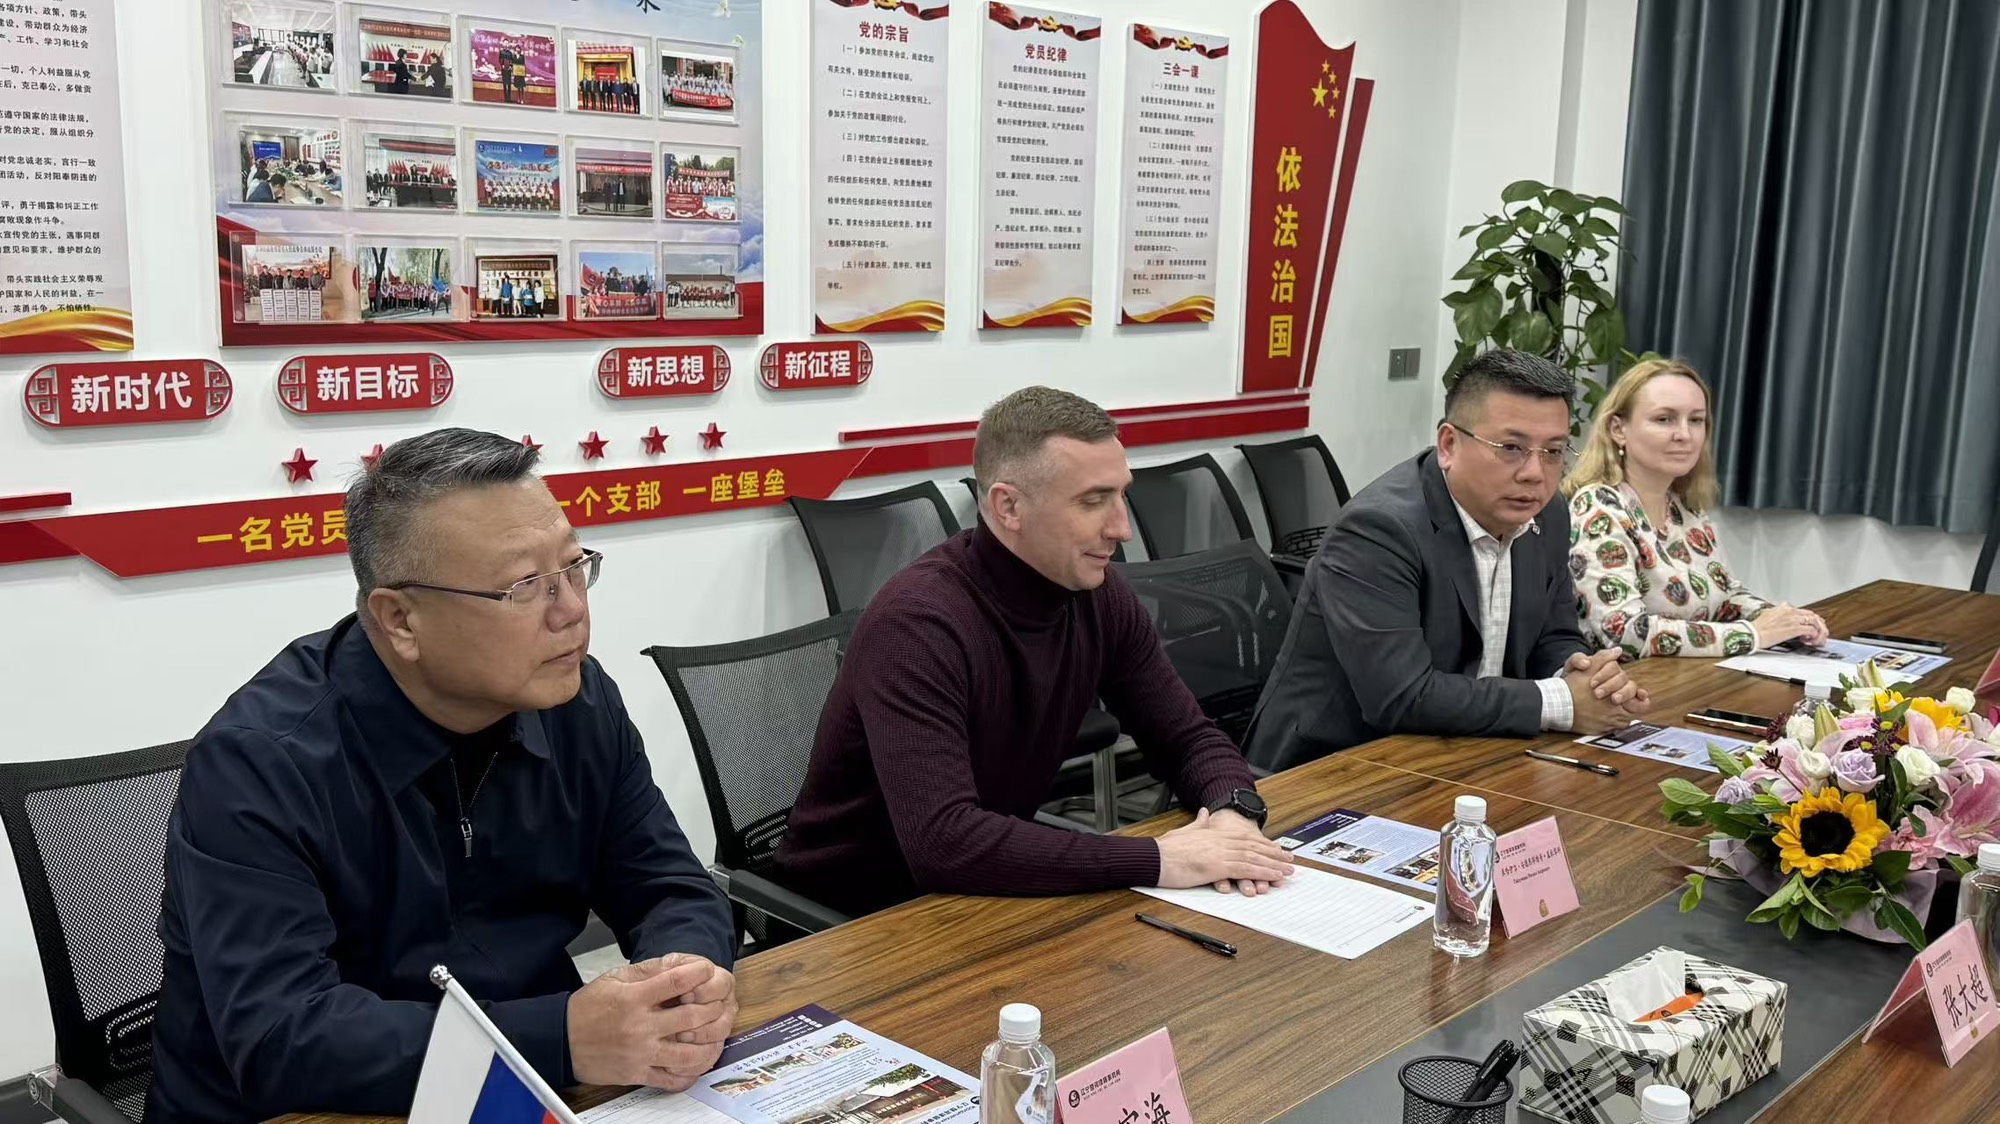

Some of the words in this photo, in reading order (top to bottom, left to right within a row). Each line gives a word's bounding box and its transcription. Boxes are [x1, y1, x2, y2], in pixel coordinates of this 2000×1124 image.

[859, 21, 909, 43] 党的宗旨
[1025, 44, 1068, 62] 党员纪律
[1163, 62, 1199, 78] 三会一课
[0, 125, 94, 138] 党的决定，服从组织分
[0, 231, 100, 240] 宣传党的主张，遇事同群
[0, 245, 101, 254] 意见和要求，维护群众的
[1268, 146, 1302, 358] 依法治国
[0, 303, 97, 313] ，英勇斗争，不怕牺牲。
[626, 355, 706, 387] 新思想
[784, 350, 851, 380] 新征程
[70, 371, 193, 414] 新时代
[316, 364, 420, 401] 新目标
[196, 510, 347, 553] 一名党员
[556, 480, 661, 517] 一个支部
[682, 469, 785, 503] 一座堡垒
[1943, 964, 1989, 1029] 张大超
